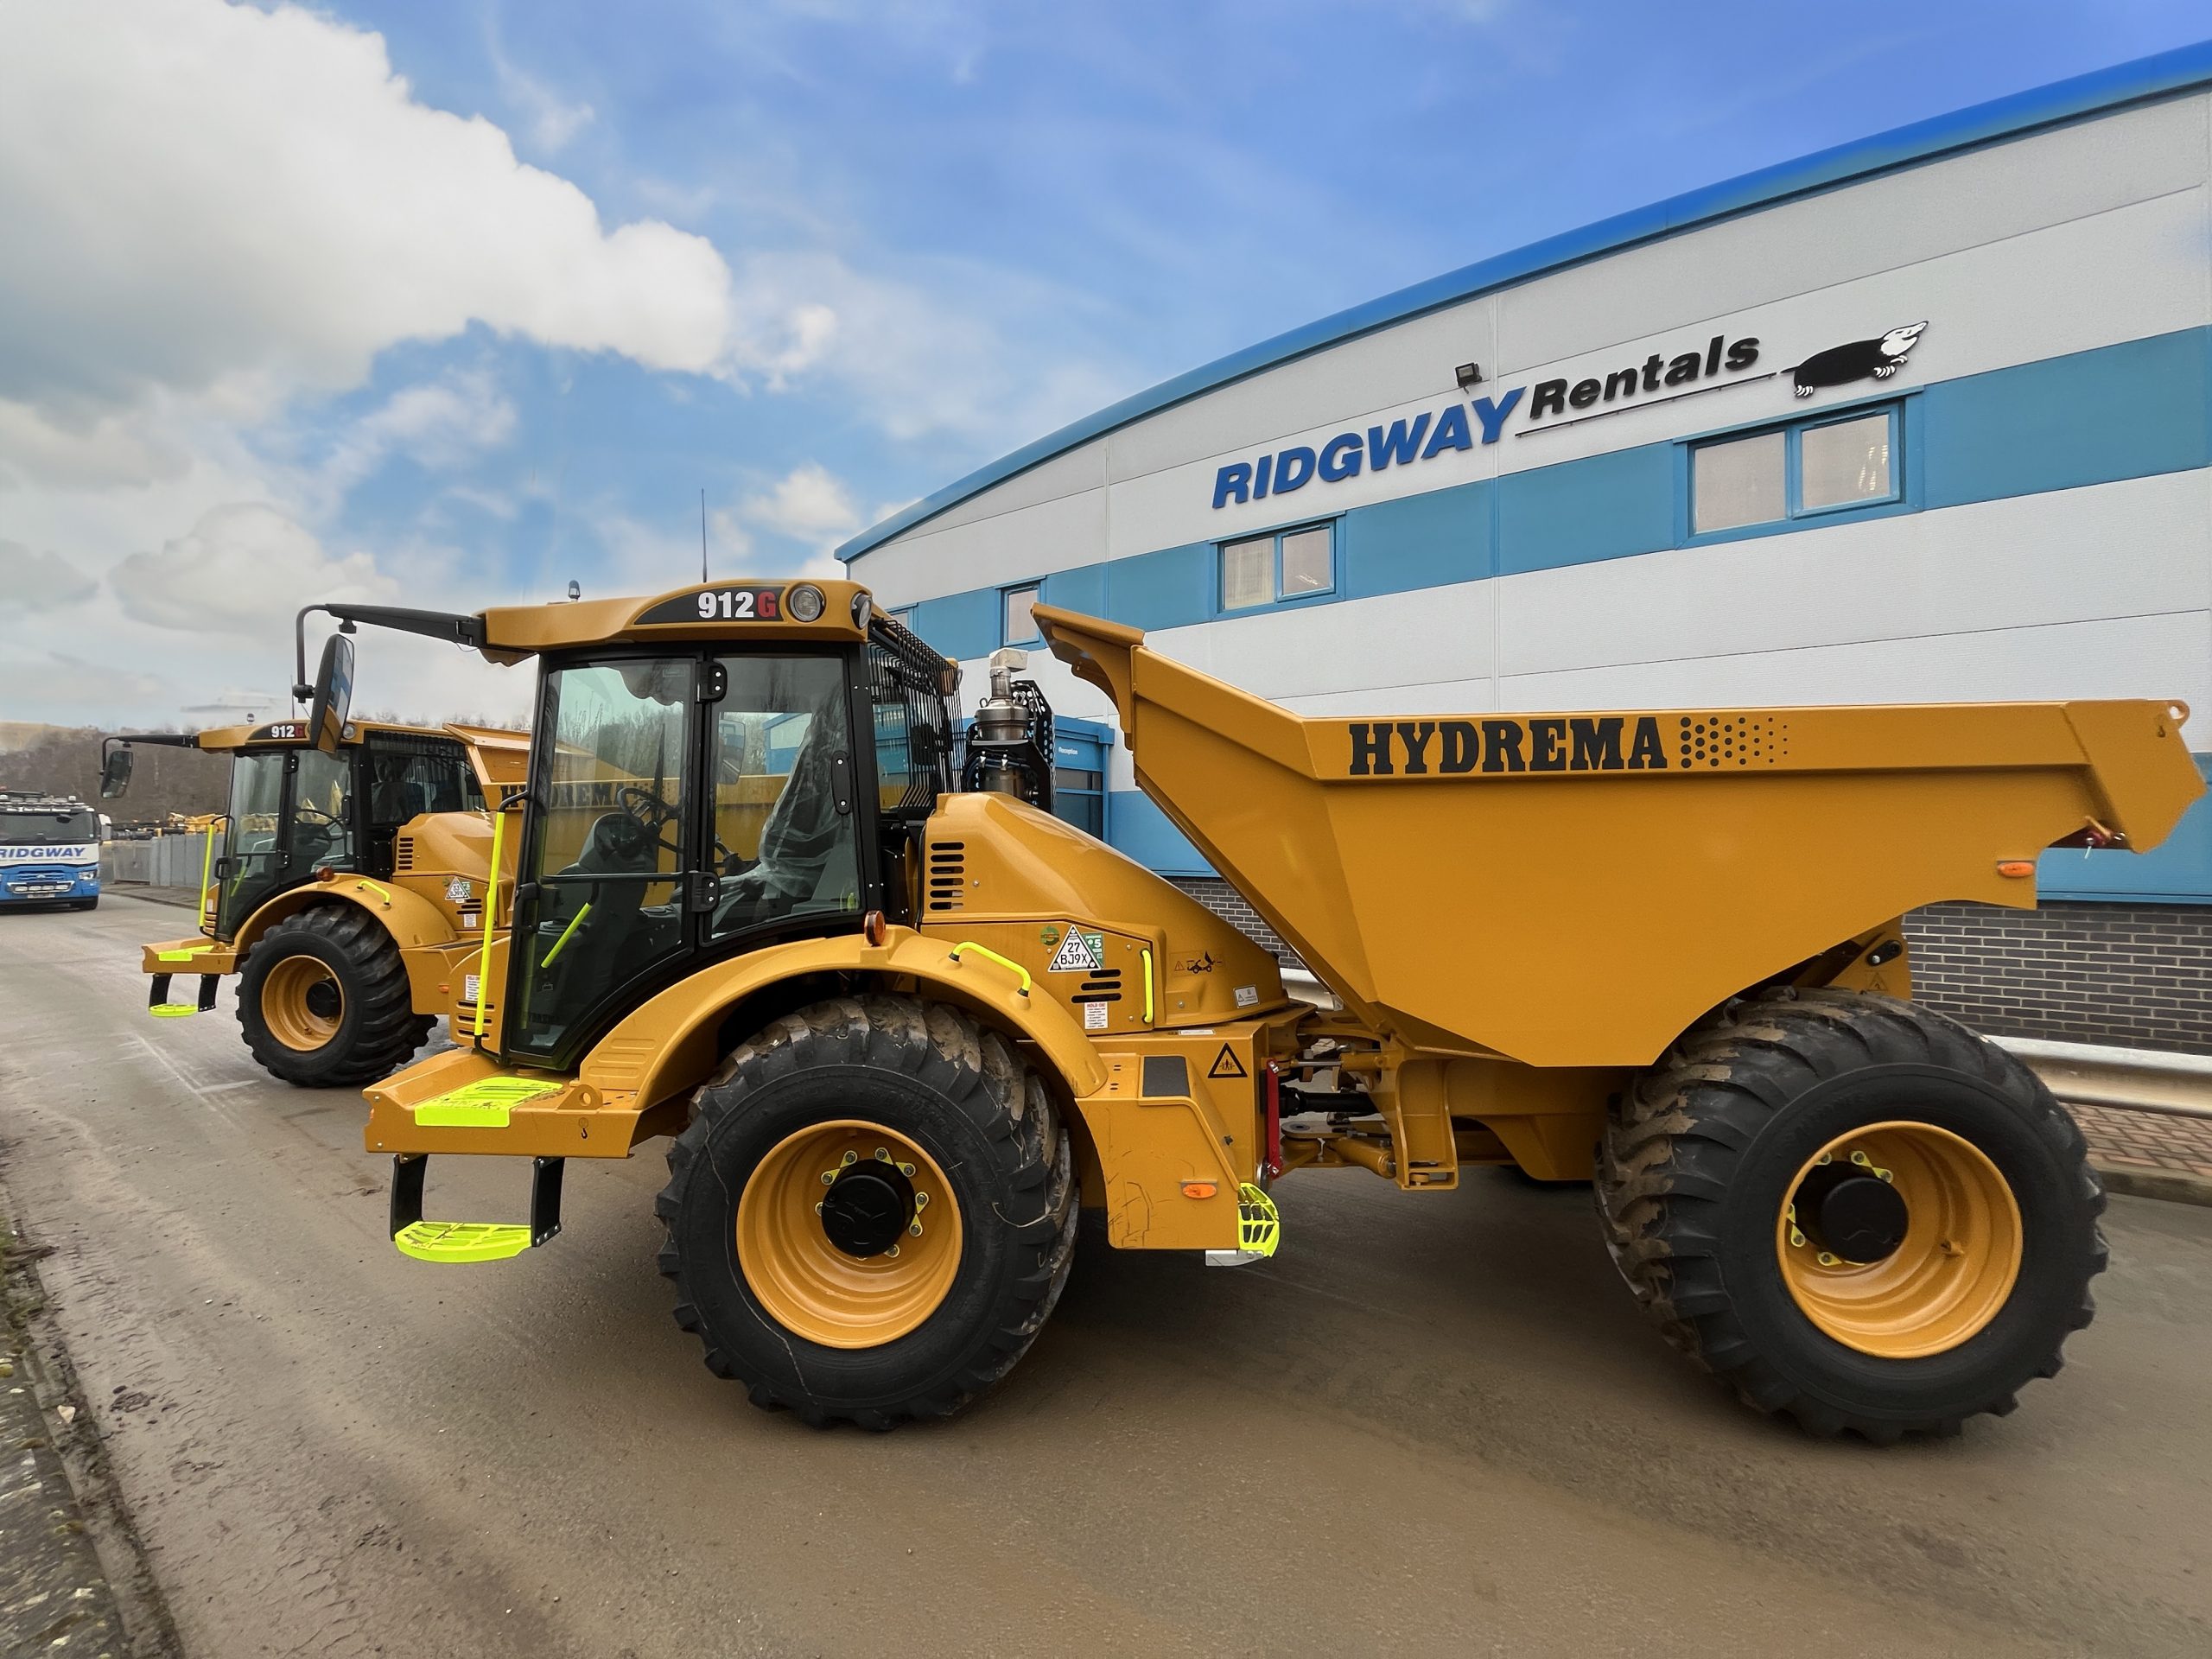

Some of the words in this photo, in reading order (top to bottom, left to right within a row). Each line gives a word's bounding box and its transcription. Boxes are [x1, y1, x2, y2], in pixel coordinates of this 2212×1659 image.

[1211, 386, 1527, 509] RIDGWAY
[1530, 334, 1760, 419] Rentals
[698, 591, 776, 619] 912G
[270, 725, 305, 738] 912G
[1348, 716, 1669, 775] HYDREMA
[1067, 942, 1080, 953] 27
[1094, 938, 1102, 948] 5
[1060, 953, 1088, 965] BJ9X
